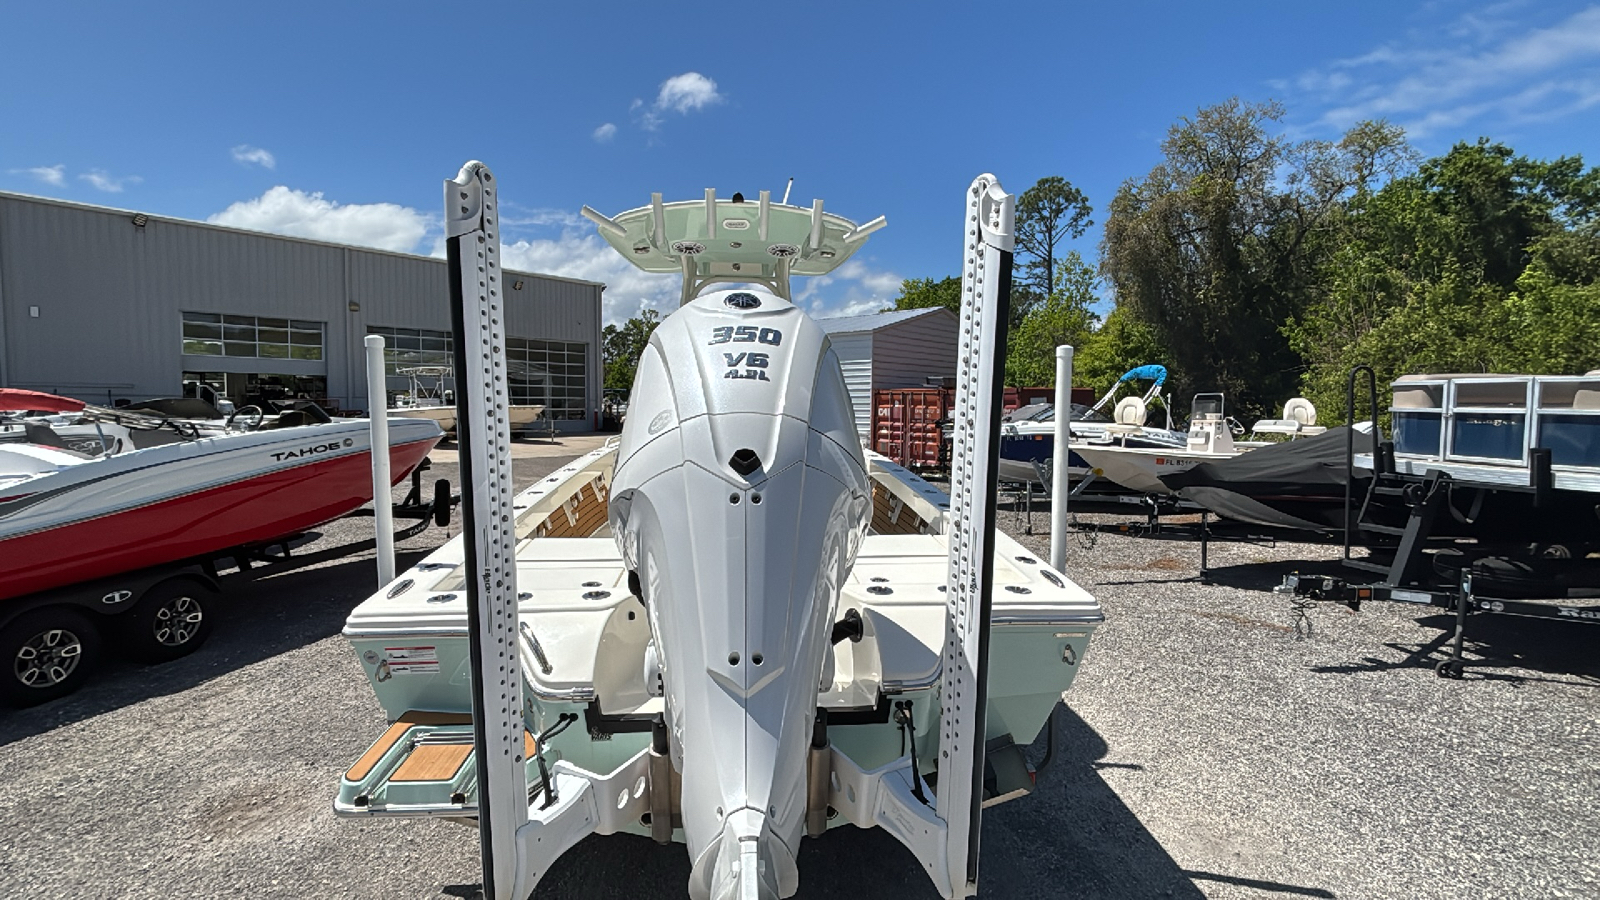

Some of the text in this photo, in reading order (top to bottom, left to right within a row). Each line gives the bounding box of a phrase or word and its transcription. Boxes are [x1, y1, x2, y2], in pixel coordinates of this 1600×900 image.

[708, 325, 782, 346] 350
[723, 352, 770, 368] V6
[270, 441, 341, 461] TAHOE
